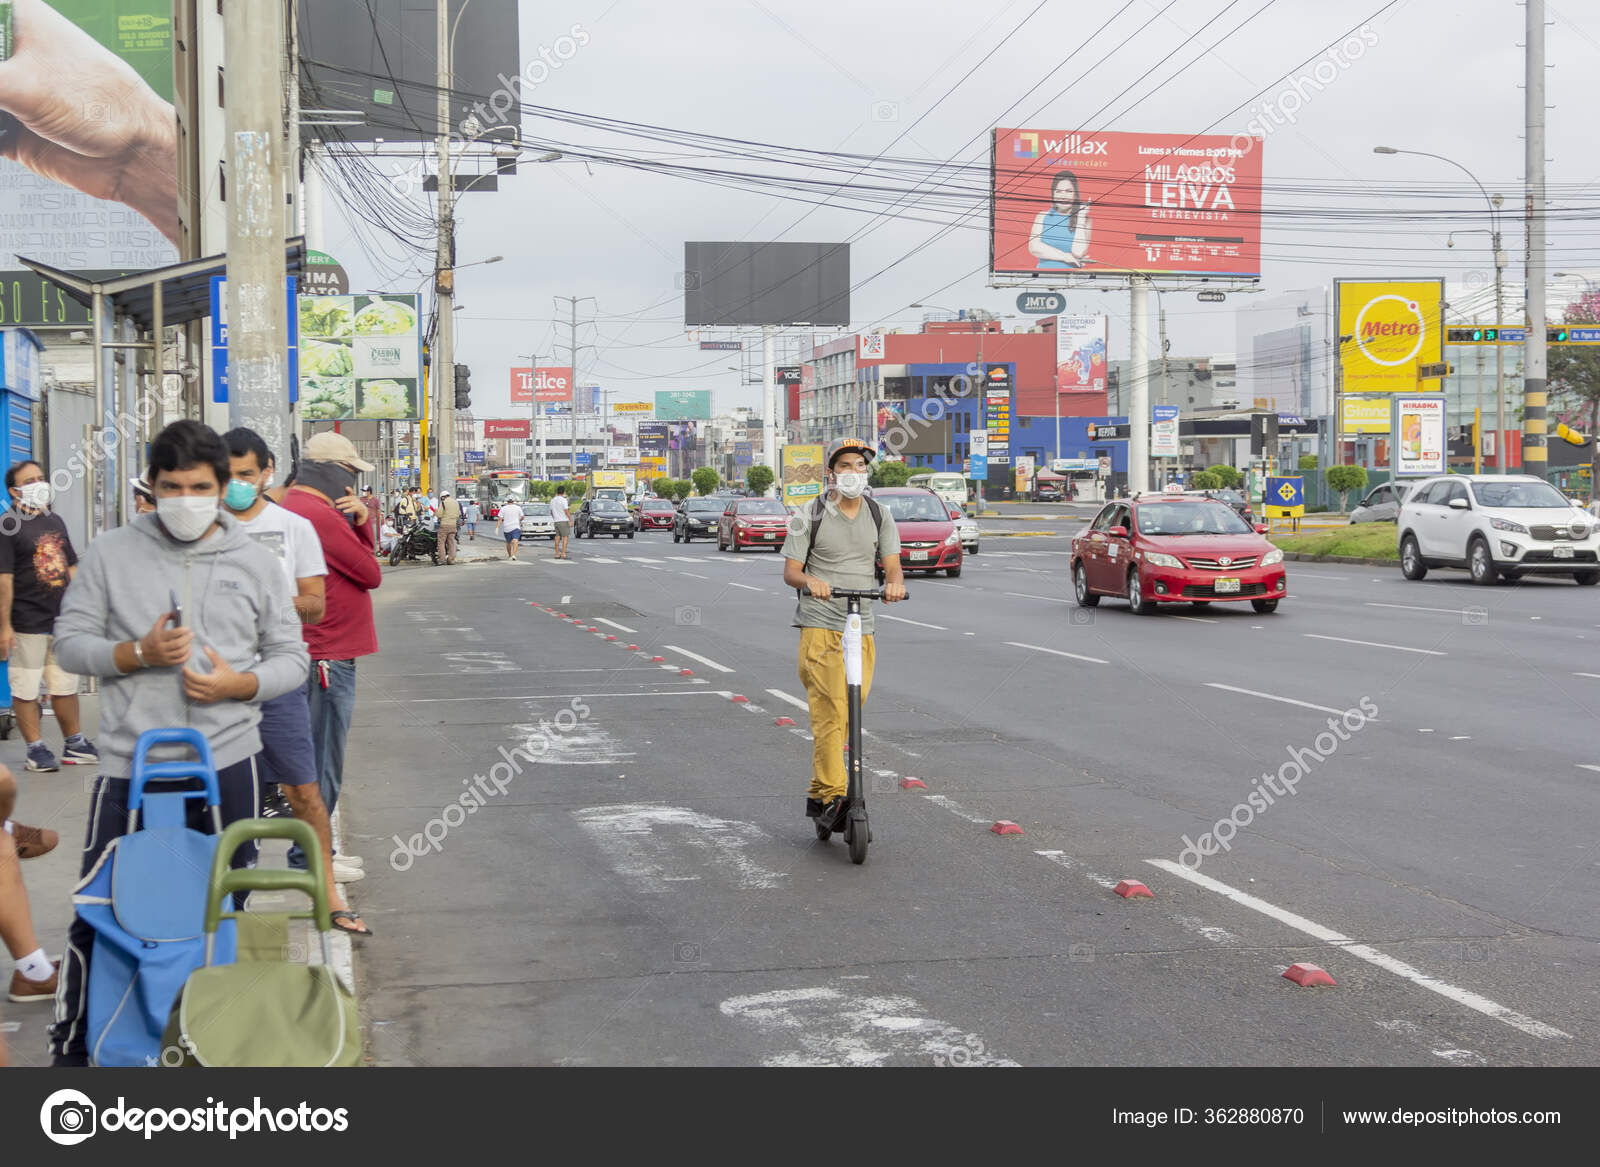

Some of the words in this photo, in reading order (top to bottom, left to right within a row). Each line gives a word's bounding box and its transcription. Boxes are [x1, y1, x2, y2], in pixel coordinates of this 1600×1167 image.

[1043, 134, 1108, 156] willax
[1138, 145, 1163, 156] Lunes
[1145, 164, 1236, 184] MILAGROS
[1145, 182, 1236, 211] LEIVA
[1152, 209, 1228, 221] ENTREVISTA
[1025, 296, 1047, 308] JMT
[1361, 321, 1419, 337] Metro
[1166, 485, 1181, 493] TAXI
